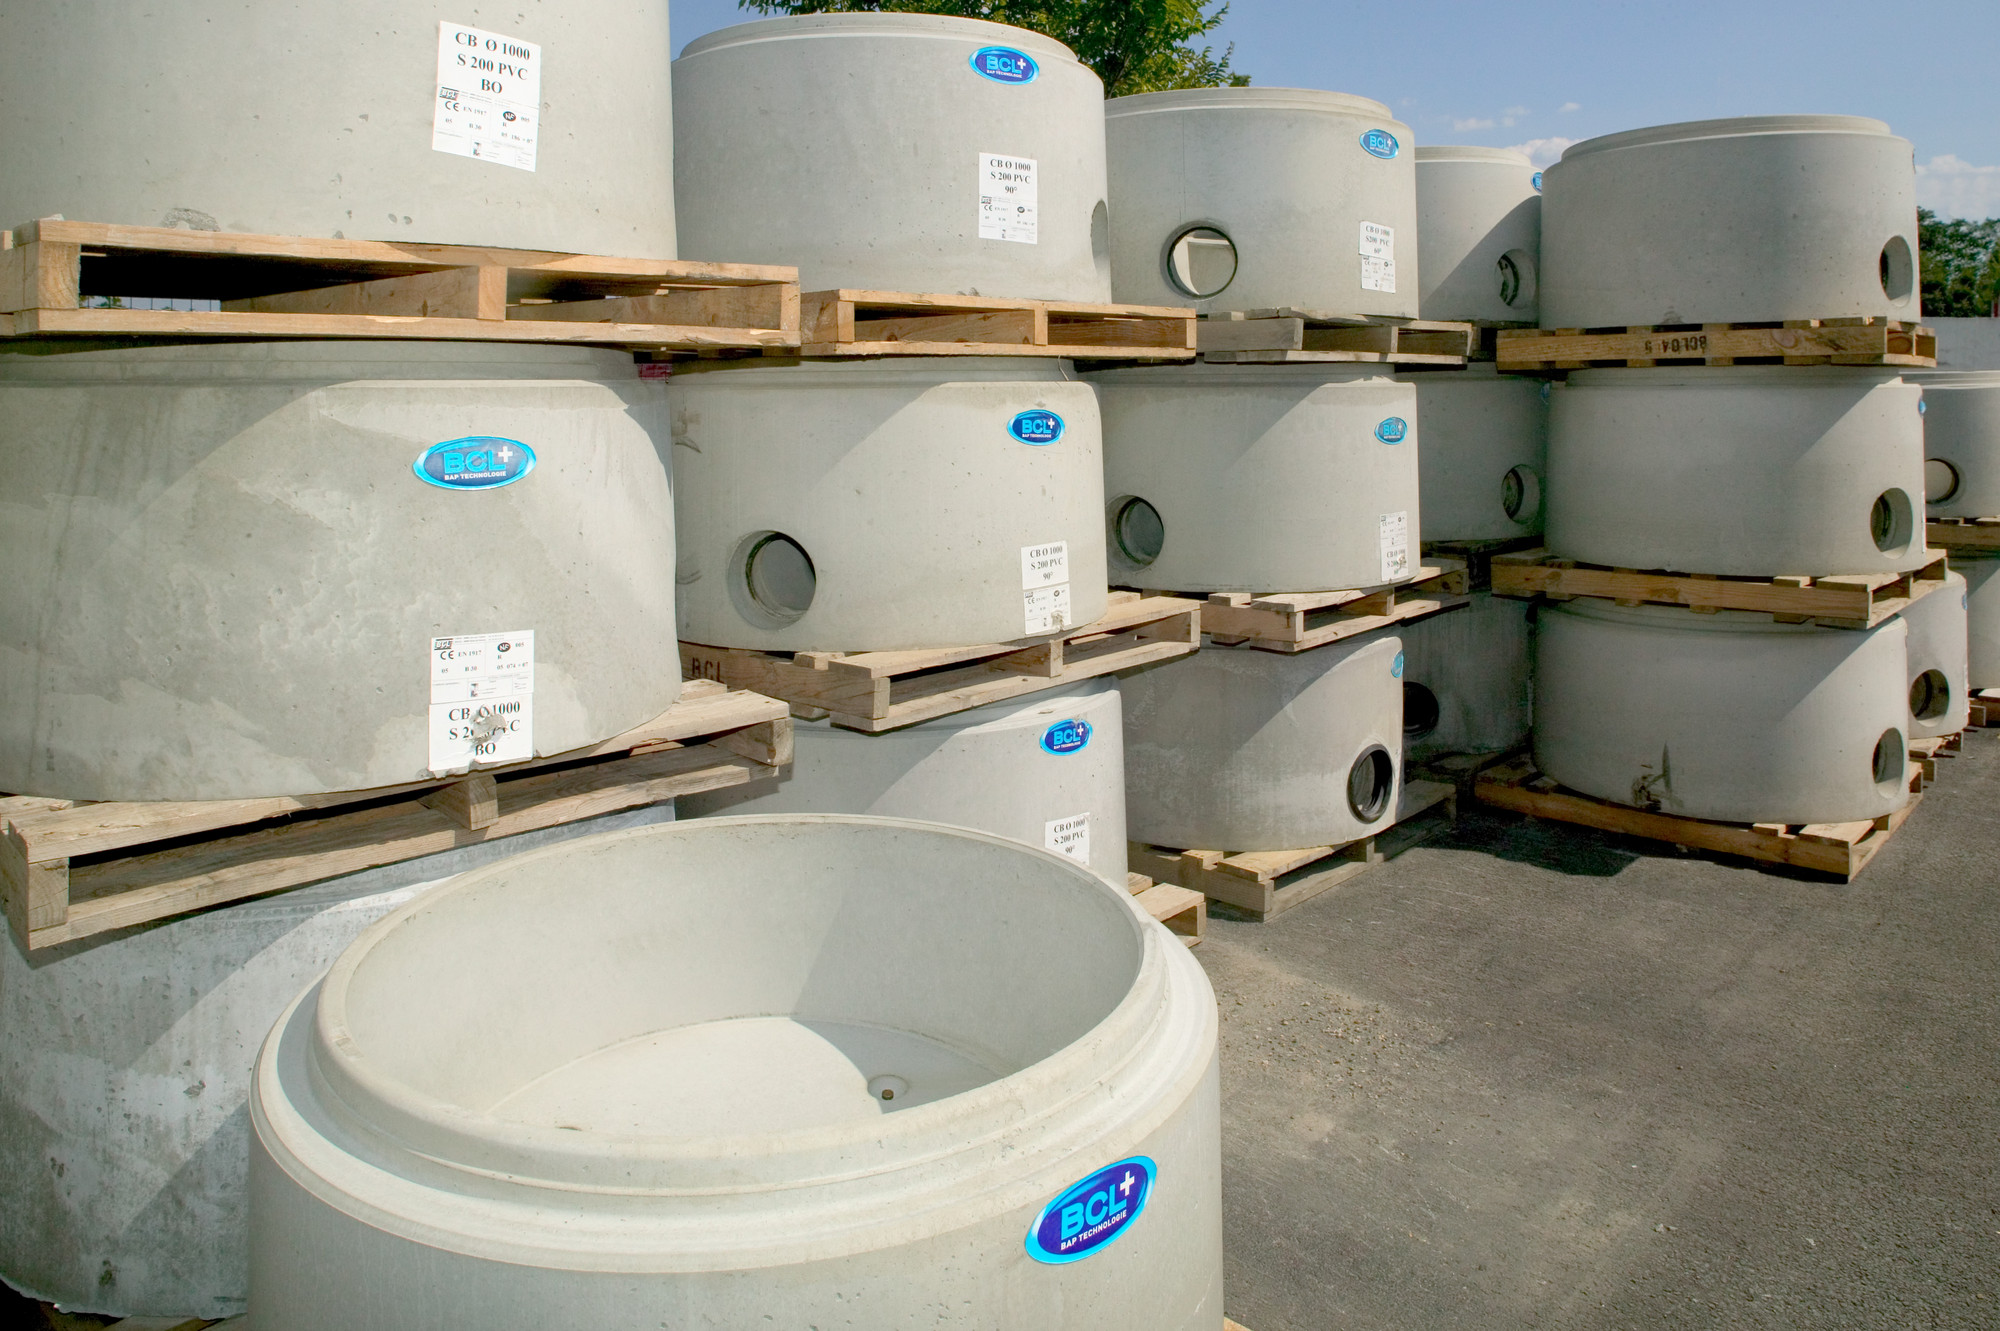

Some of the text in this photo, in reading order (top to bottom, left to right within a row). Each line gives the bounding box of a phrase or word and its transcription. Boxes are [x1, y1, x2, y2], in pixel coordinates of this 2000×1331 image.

[456, 32, 478, 47] CB
[502, 43, 530, 60] 1000
[457, 54, 528, 80] S 200 PVC
[481, 78, 503, 94] BO
[990, 158, 1003, 168] CB
[1014, 162, 1031, 172] 1000
[990, 171, 1031, 184] S 200 PVC
[460, 471, 507, 479] TECHNOLOGIE
[1030, 549, 1041, 558] CB
[1050, 545, 1062, 555] 1000
[1031, 557, 1063, 570] S 200 PVC
[449, 708, 470, 721] CB
[493, 701, 520, 714] 1000
[450, 728, 458, 740] S
[475, 742, 496, 756] BO
[1054, 824, 1064, 833] CB
[1073, 818, 1086, 828] 1000
[1054, 830, 1085, 845] S 200 PVC
[1060, 1209, 1127, 1250] BAP TECHNOLOGIE
